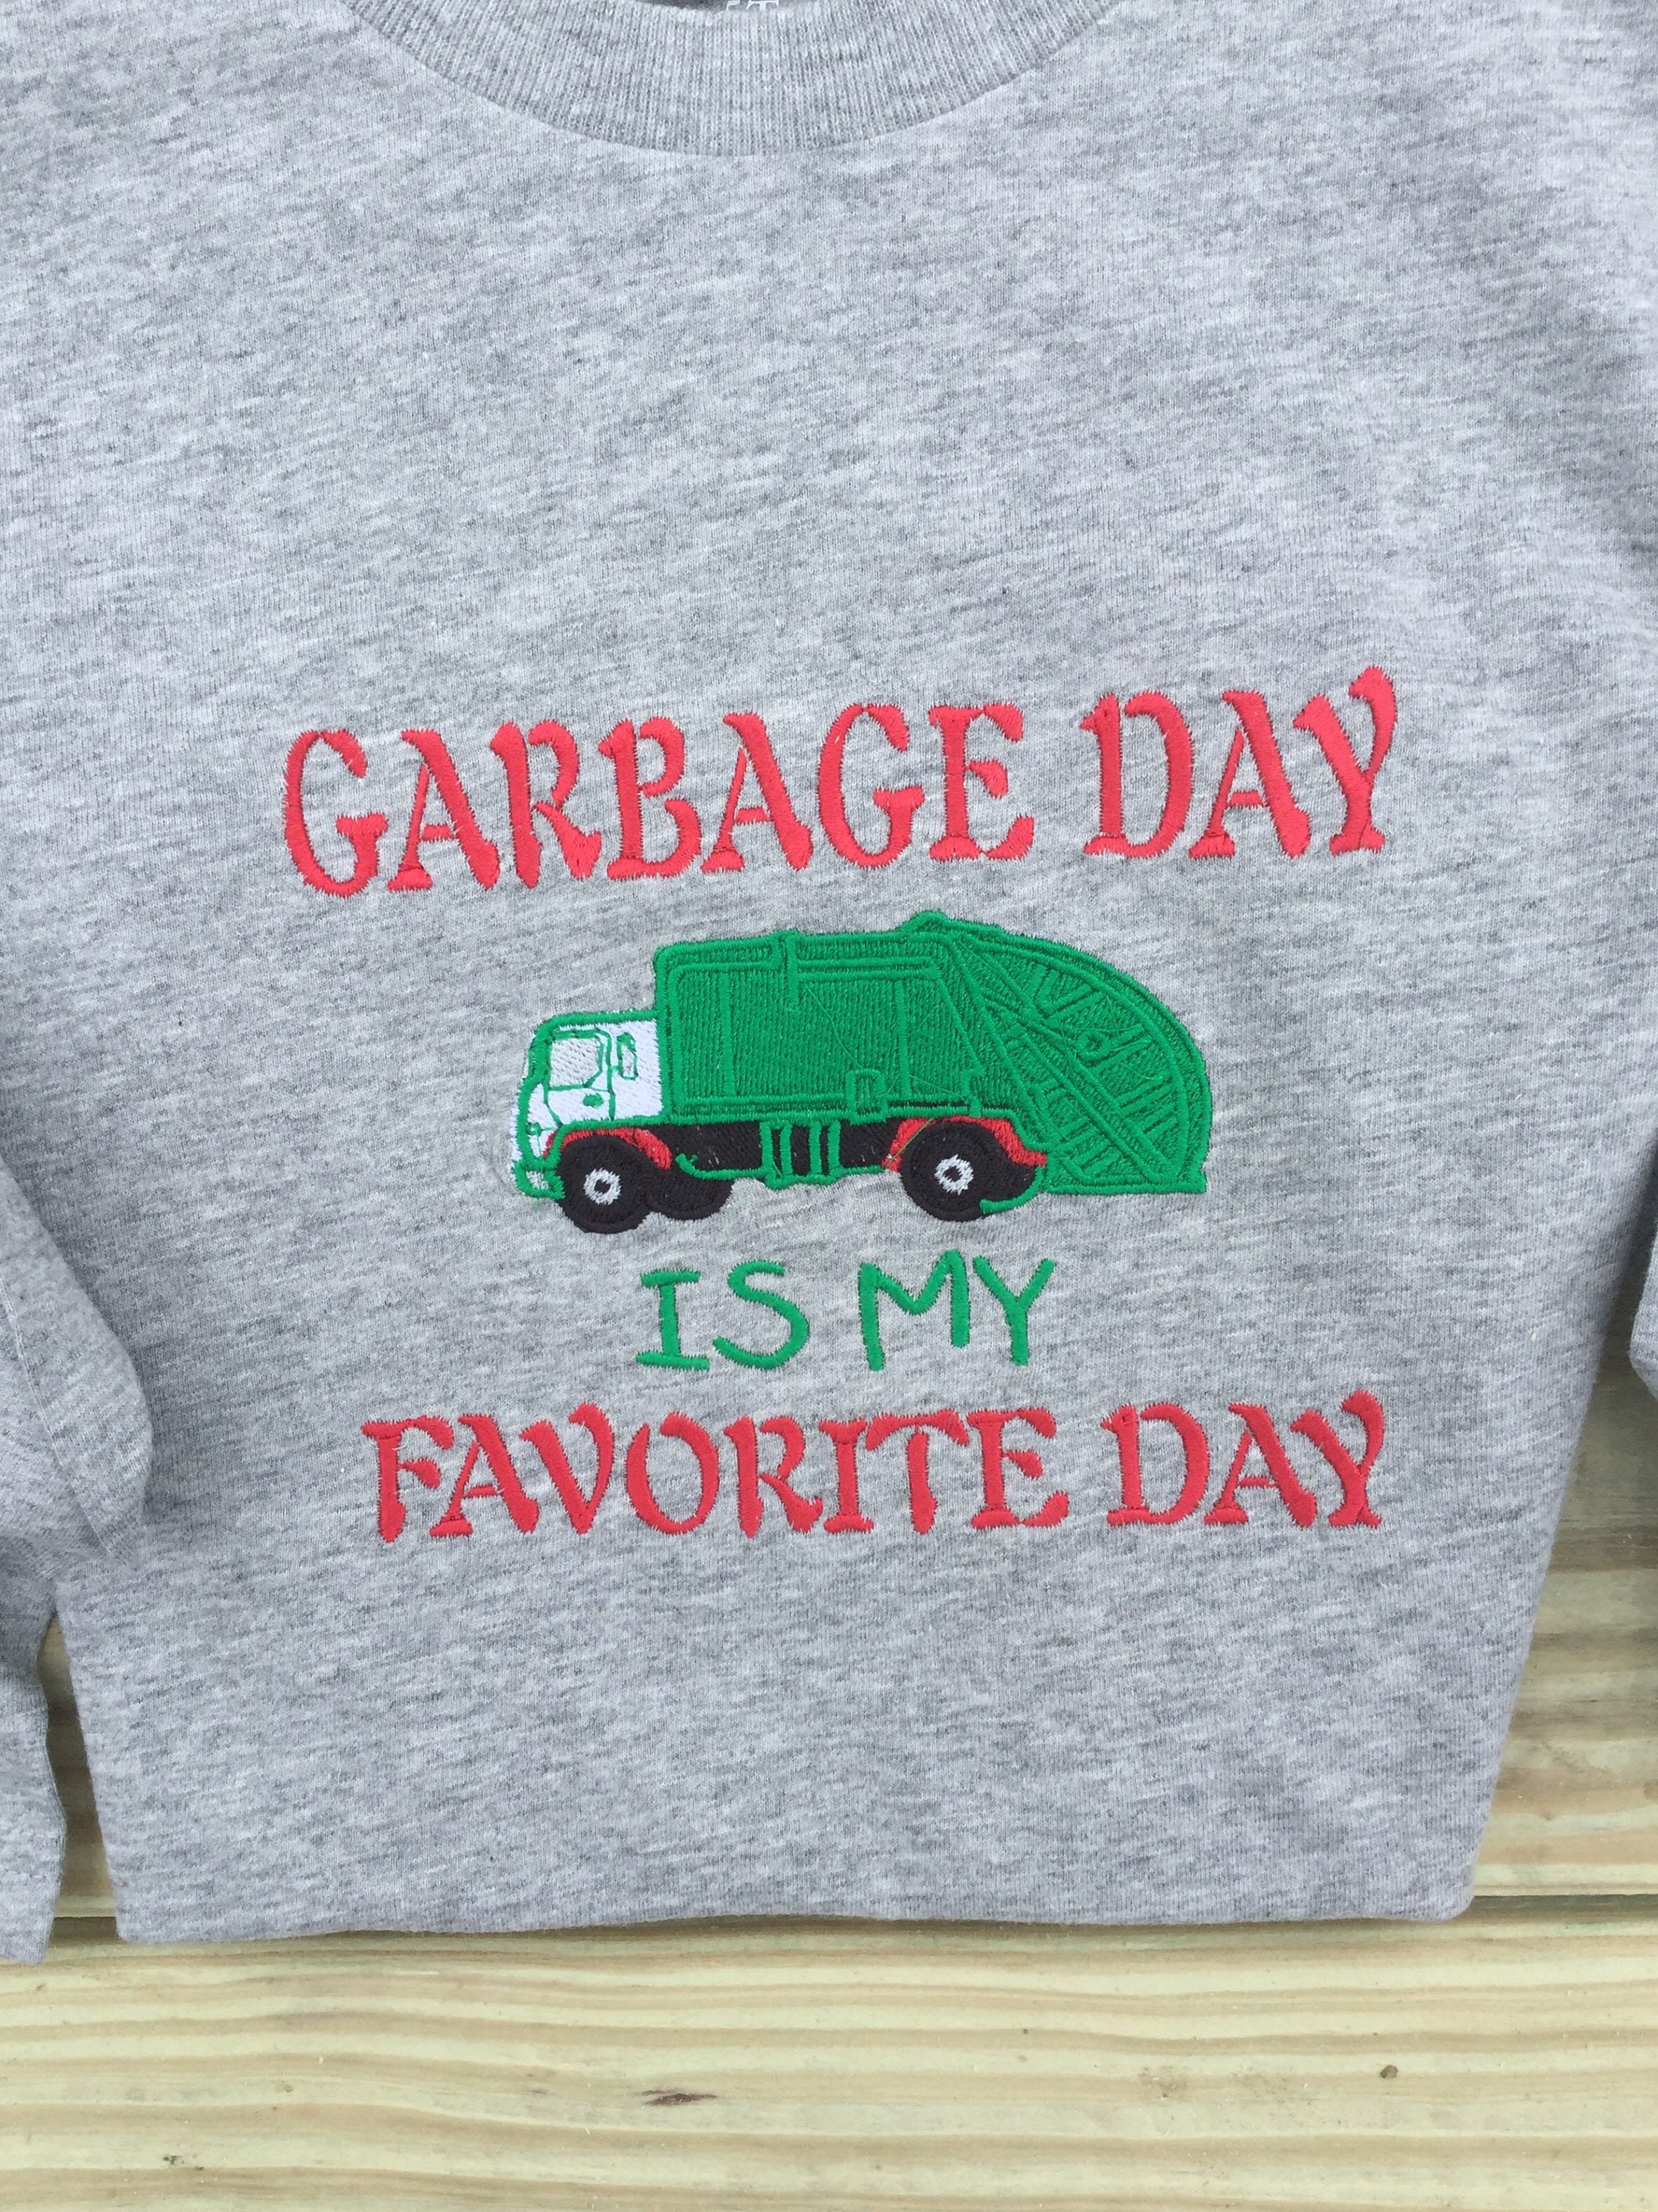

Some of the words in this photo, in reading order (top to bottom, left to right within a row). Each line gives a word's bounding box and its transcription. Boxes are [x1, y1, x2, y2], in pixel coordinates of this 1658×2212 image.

[285, 702, 1035, 898] GARBAGE
[1080, 665, 1397, 860] DAY
[636, 1259, 811, 1371] IS
[858, 1249, 1056, 1371] MY
[361, 1402, 1069, 1543] FAVORITE
[1101, 1390, 1384, 1528] DAY
